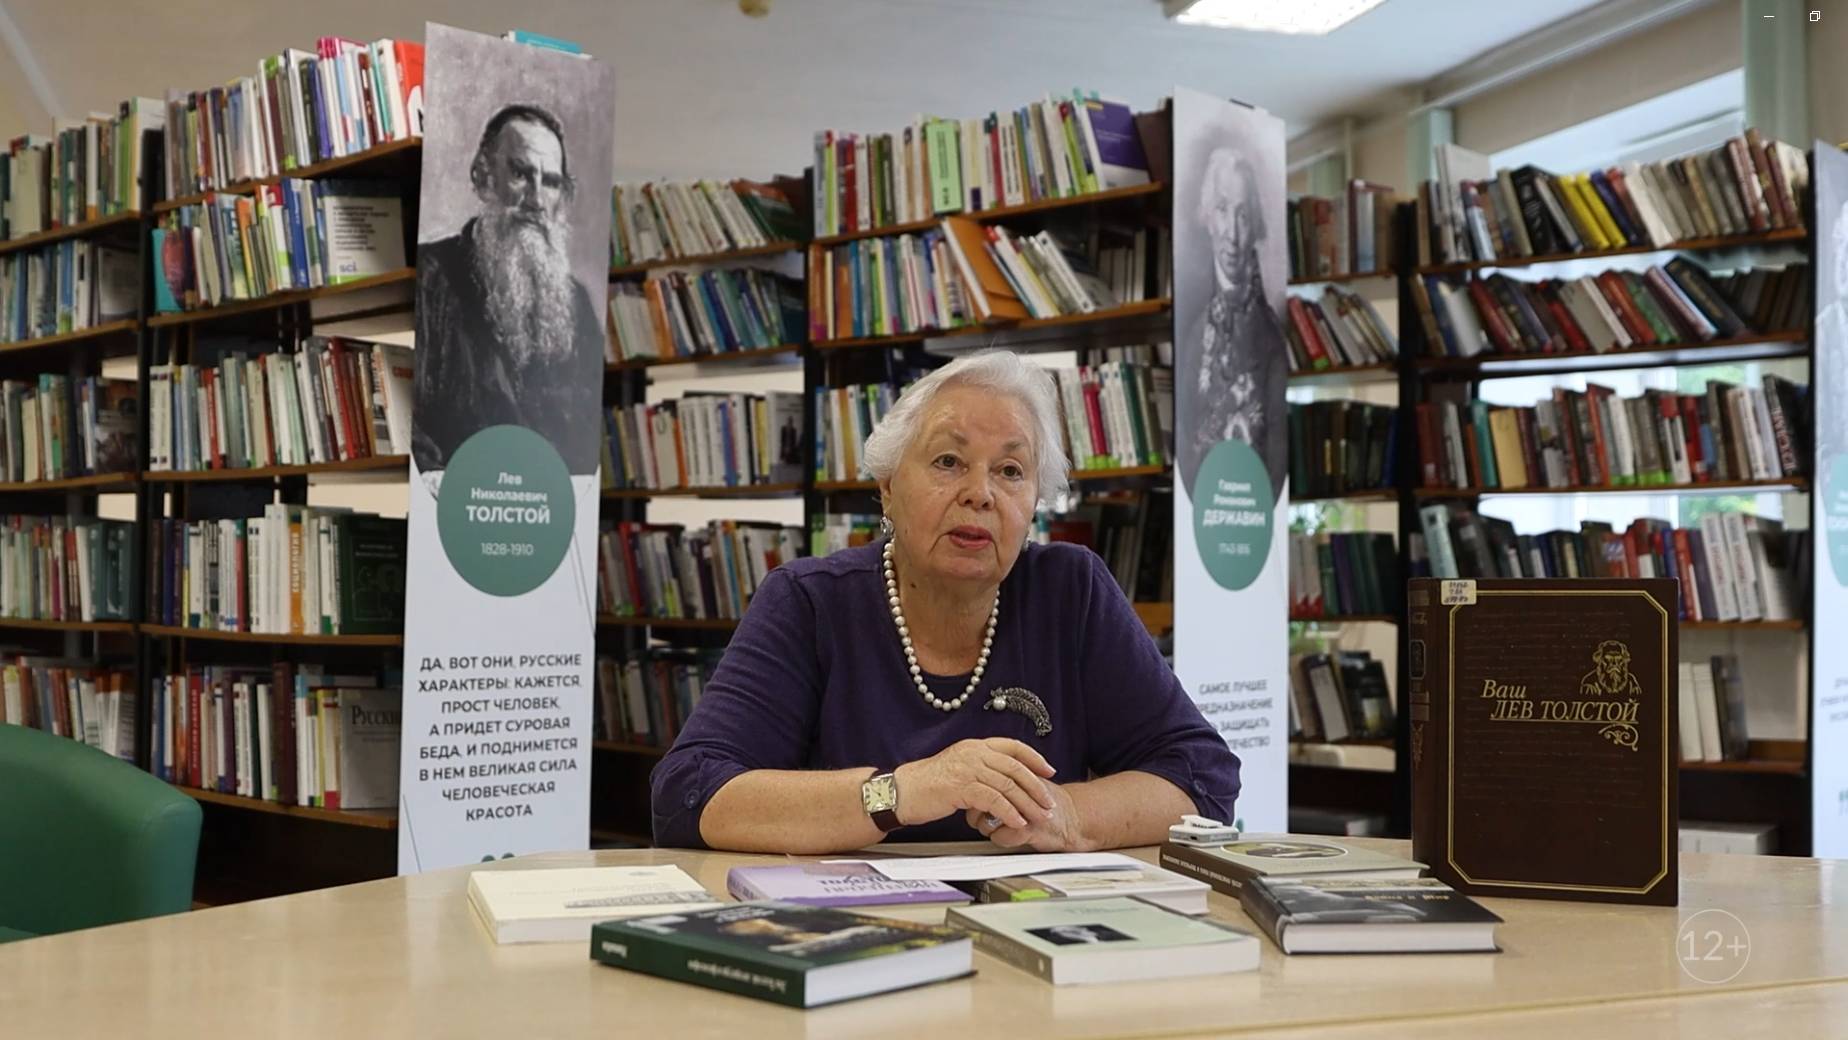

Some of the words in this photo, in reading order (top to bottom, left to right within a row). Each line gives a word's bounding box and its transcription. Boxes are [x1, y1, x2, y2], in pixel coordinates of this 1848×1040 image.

[497, 471, 523, 485] Лев
[470, 487, 548, 502] Николаевич
[465, 504, 551, 524] ТОЛСТОЙ
[1202, 509, 1266, 527] ДЕРЖАВИН
[480, 542, 535, 556] 1828-1910
[449, 656, 479, 670] ВОТ
[519, 653, 582, 668] РУССКИЕ
[1480, 679, 1527, 699] Ваш
[441, 699, 491, 714] ПРОСТ
[1196, 697, 1273, 715] РЕДНАЗНАЧЕНИЕ
[1490, 699, 1534, 719] ЛЕВ
[1540, 698, 1640, 722] ТОЛСТОЙ
[429, 724, 440, 736] А
[443, 720, 502, 736] ПРИДЕТ
[505, 717, 571, 733] СУРОВАЯ
[466, 744, 477, 756] И
[481, 737, 578, 755] ПОДНИМЕТСЯ
[419, 769, 429, 781] В
[433, 766, 465, 780] НЕМ
[469, 761, 536, 778] ВЕЛИКАЯ
[539, 758, 577, 772] СИЛА
[442, 780, 556, 801] ЧЕЛОВЕЧЕСКАЯ
[465, 804, 533, 822] КРАСОТА
